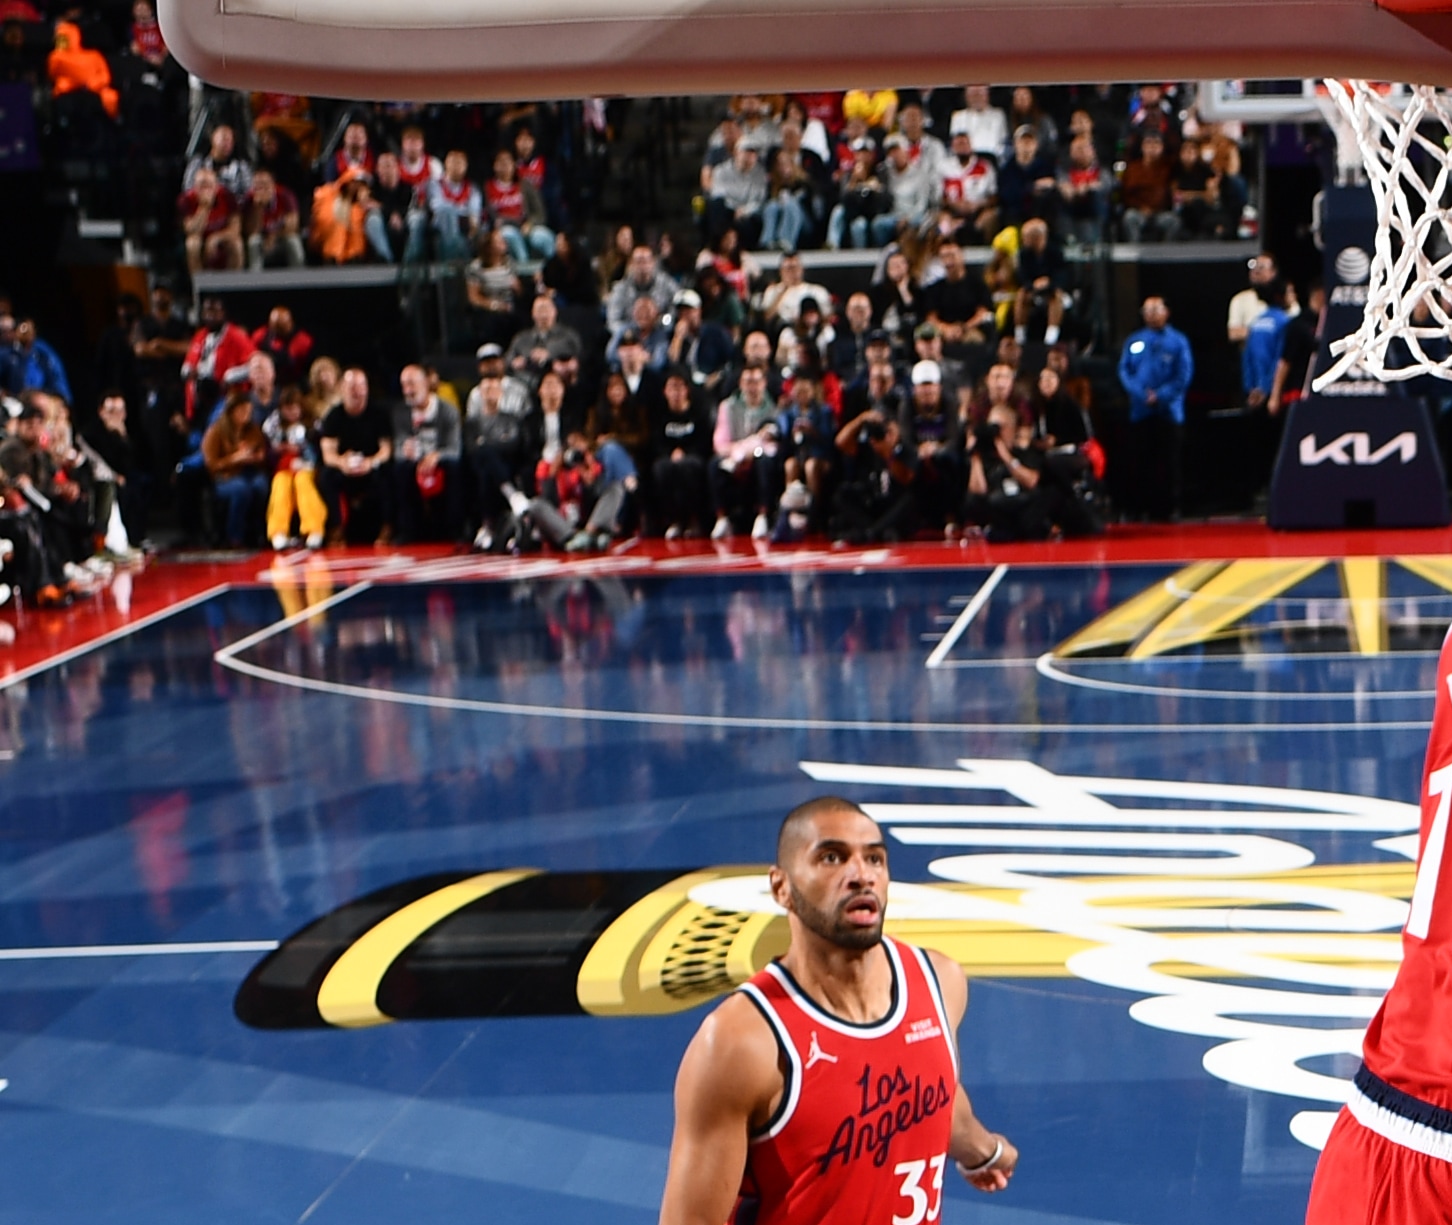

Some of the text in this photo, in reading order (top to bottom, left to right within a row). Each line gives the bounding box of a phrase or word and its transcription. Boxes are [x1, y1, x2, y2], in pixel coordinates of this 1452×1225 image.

[1329, 285, 1370, 306] AT&
[857, 1063, 912, 1118] Los
[817, 1075, 950, 1175] Angeles
